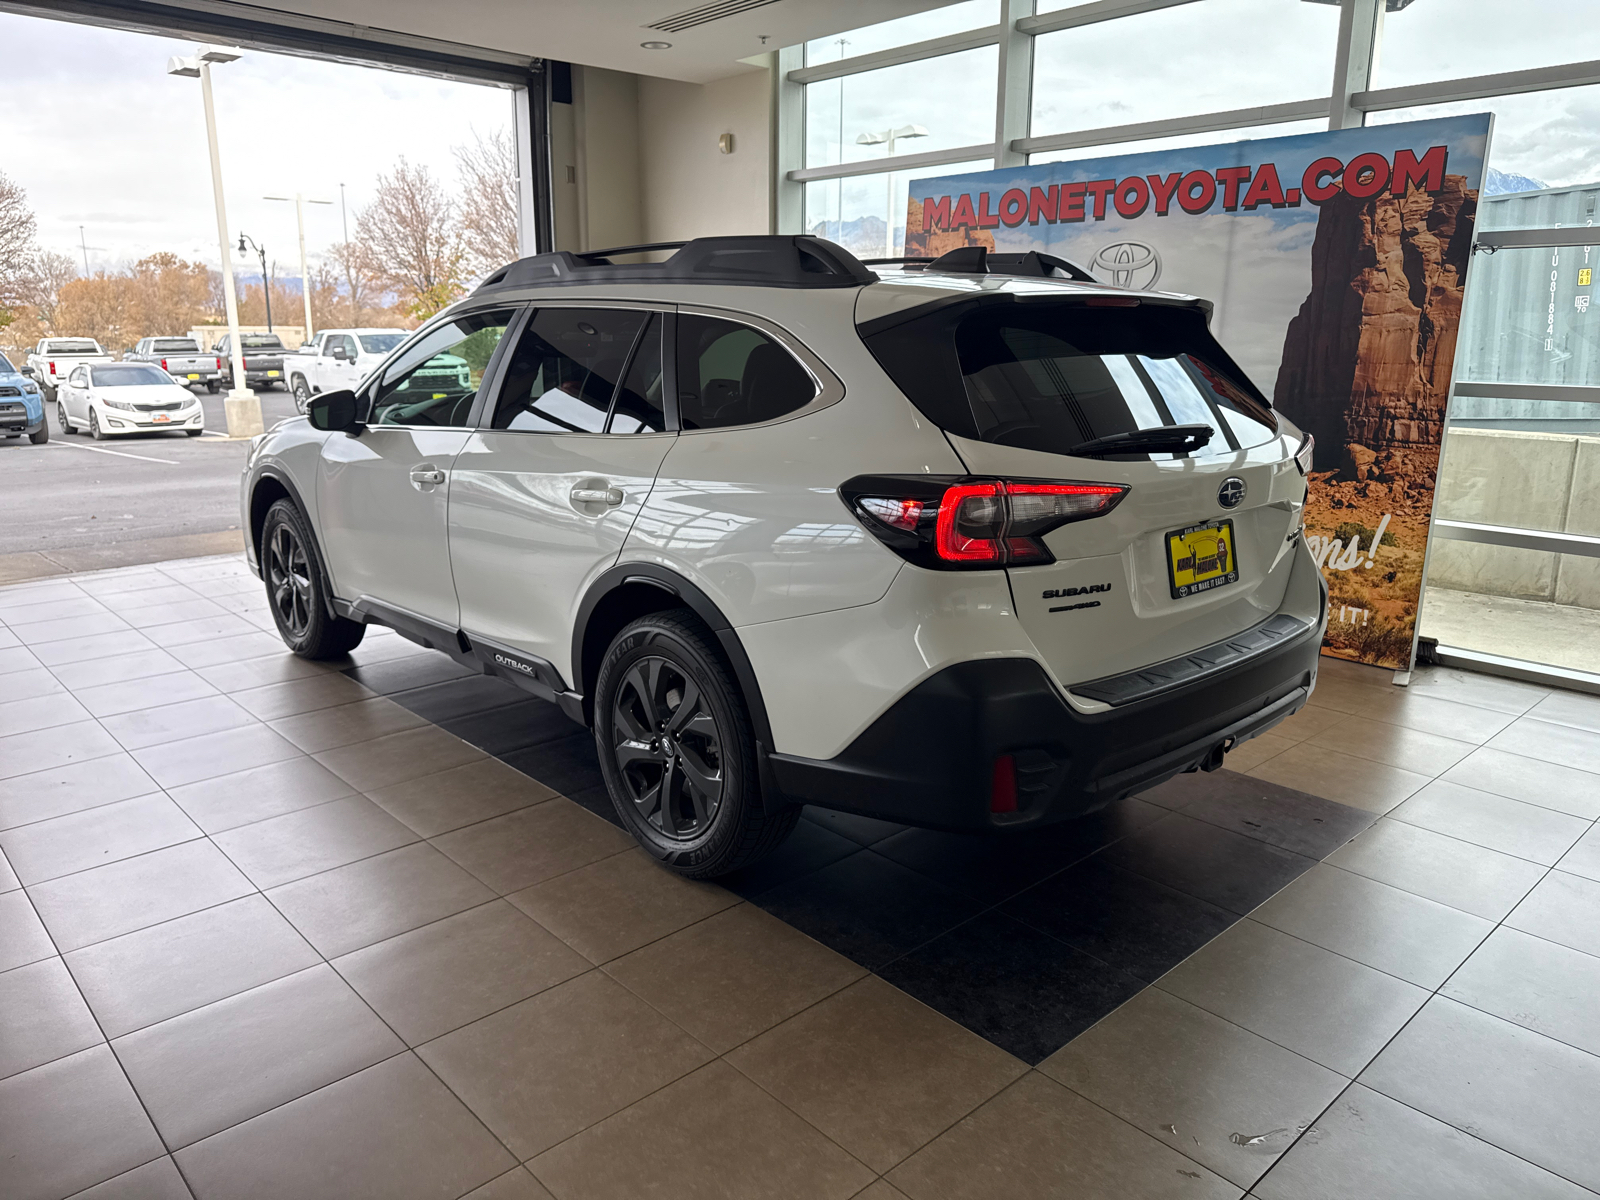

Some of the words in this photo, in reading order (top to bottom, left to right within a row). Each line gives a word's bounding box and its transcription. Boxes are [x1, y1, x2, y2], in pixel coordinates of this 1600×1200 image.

[922, 145, 1448, 232] MALONETOYOTA.COM
[1042, 582, 1112, 598] SUBARU
[1198, 581, 1210, 590] MAKE
[1215, 576, 1226, 586] EASY
[1339, 604, 1369, 627] IT!
[495, 654, 534, 675] OUTBACK
